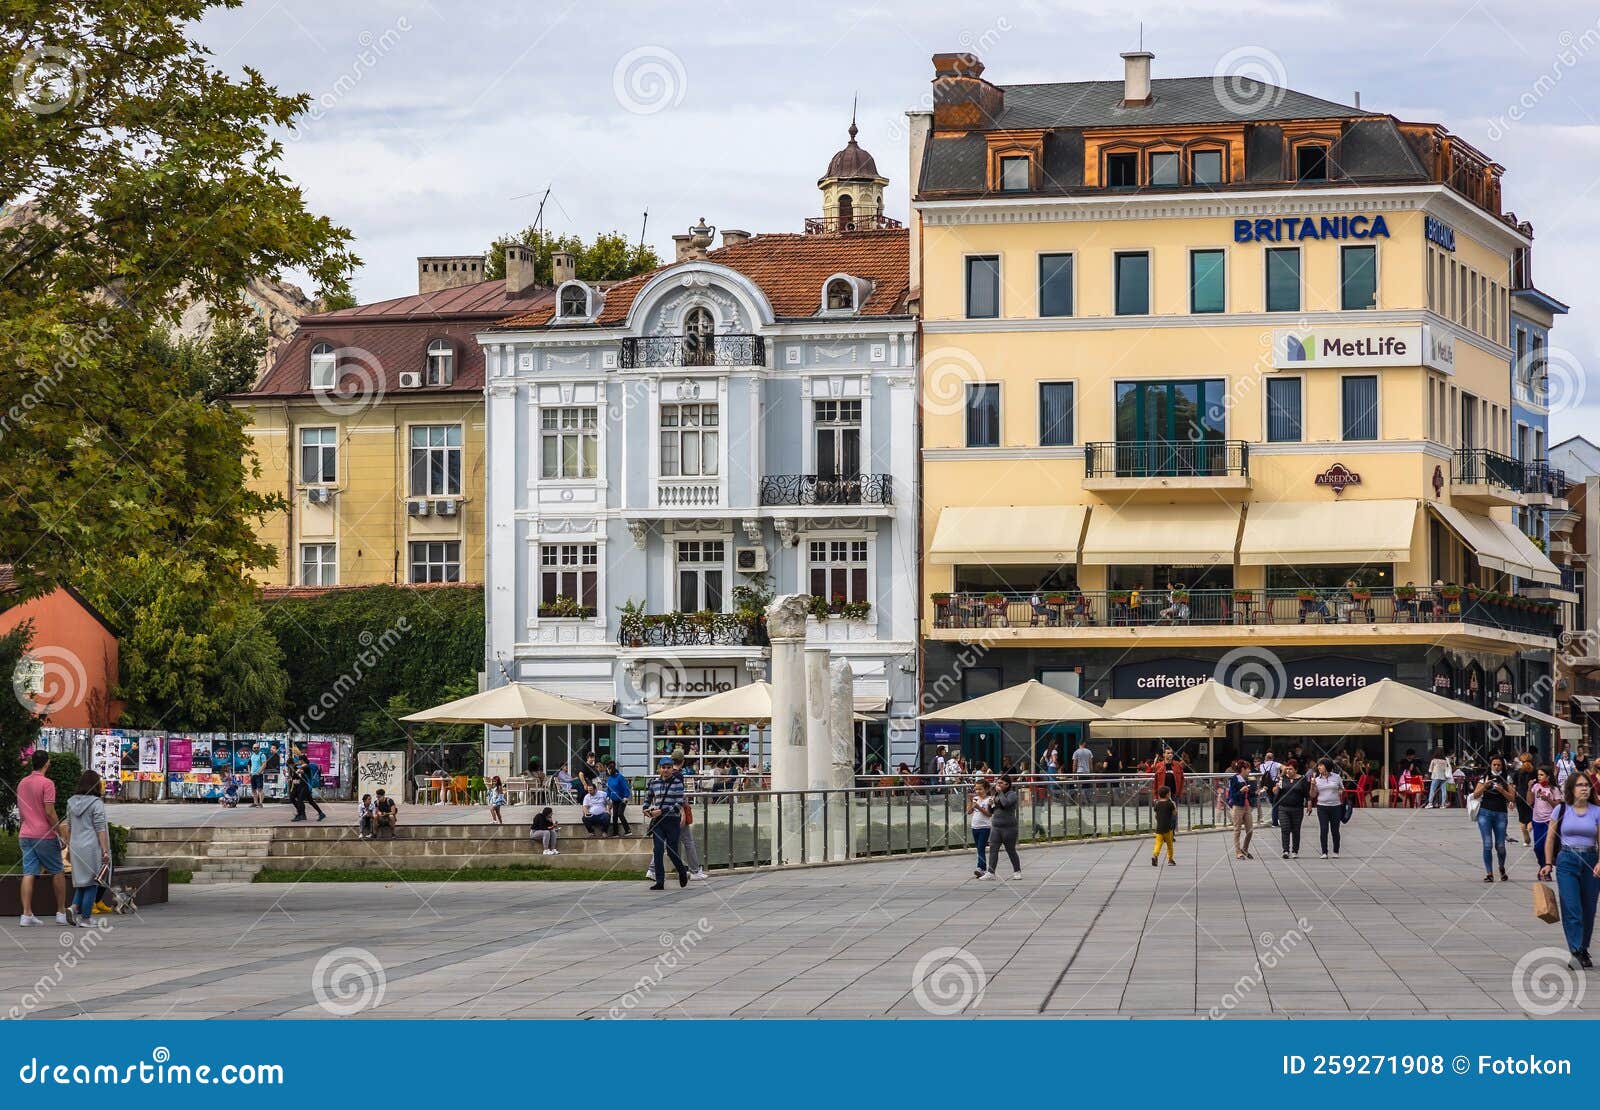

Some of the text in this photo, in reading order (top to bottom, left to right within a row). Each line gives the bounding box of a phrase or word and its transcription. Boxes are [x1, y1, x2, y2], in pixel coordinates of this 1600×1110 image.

[1234, 215, 1390, 243] BRITANICA
[1322, 335, 1407, 357] MetLife
[1136, 673, 1367, 690] caffetteri gelateria
